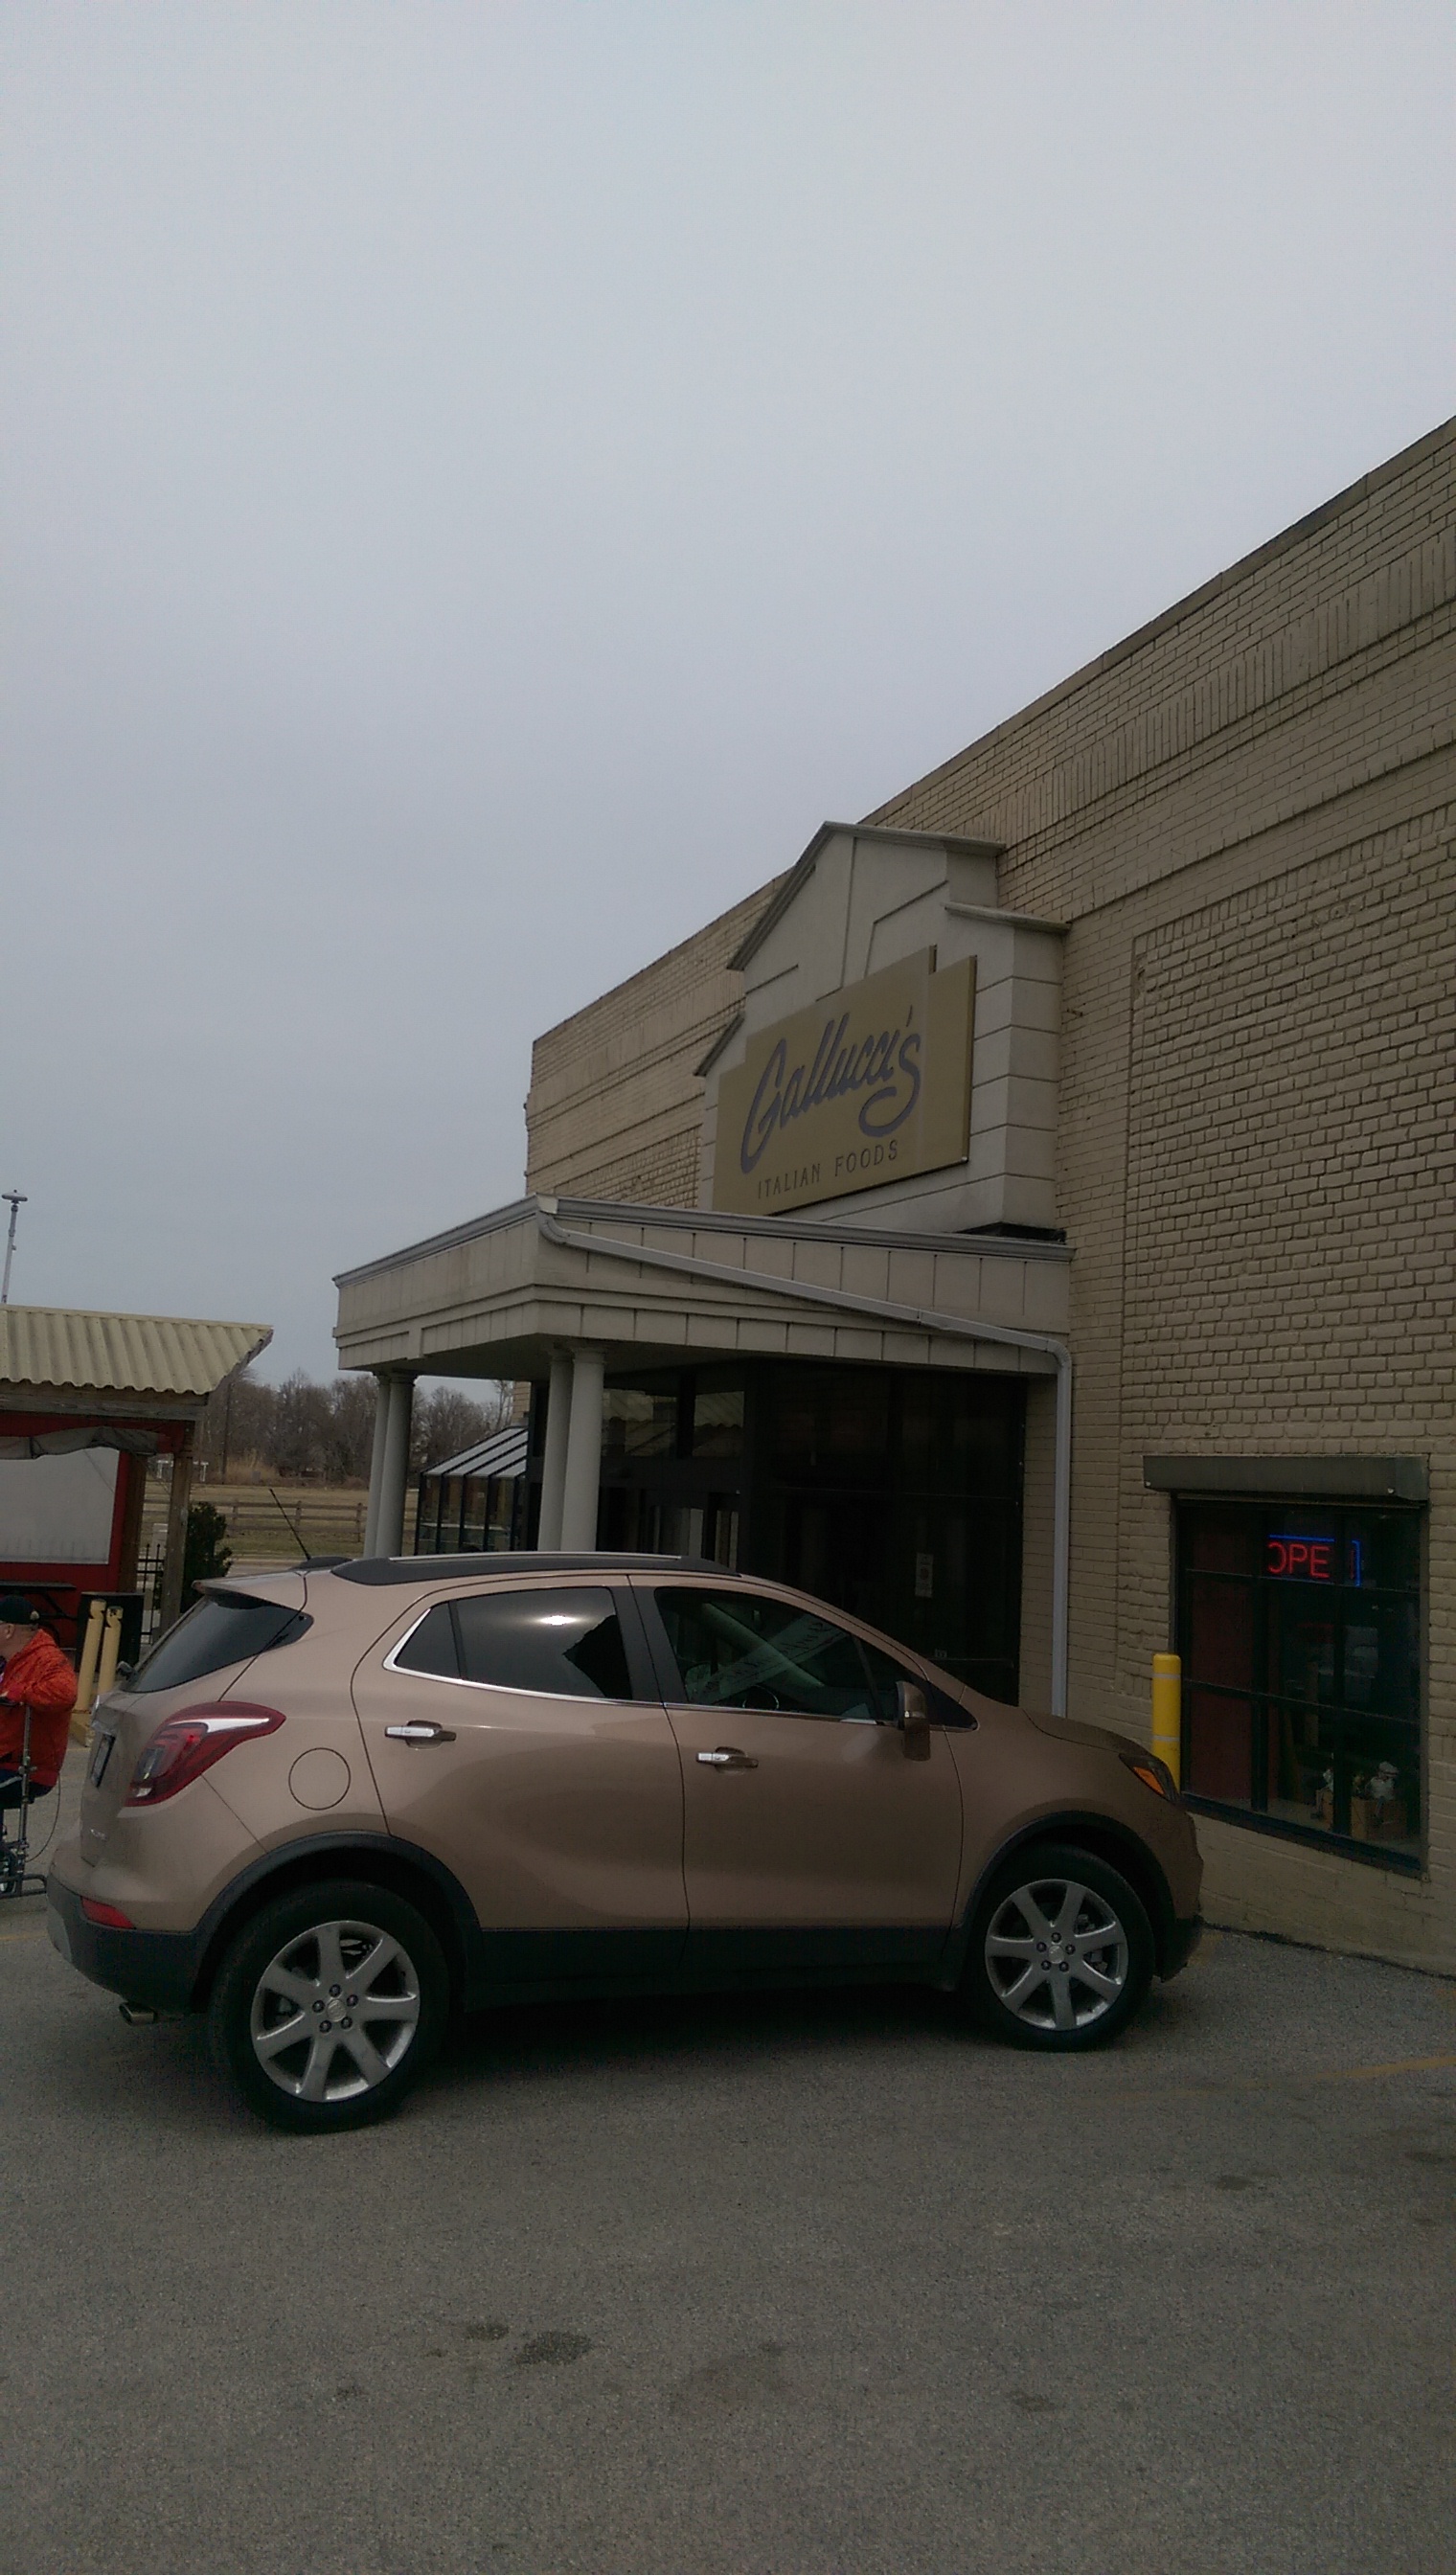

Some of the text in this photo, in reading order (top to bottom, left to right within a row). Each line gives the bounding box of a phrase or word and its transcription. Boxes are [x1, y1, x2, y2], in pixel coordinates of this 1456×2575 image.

[758, 1140, 899, 1198] ITALIAN FOODS
[1267, 1540, 1354, 1580] OPE
